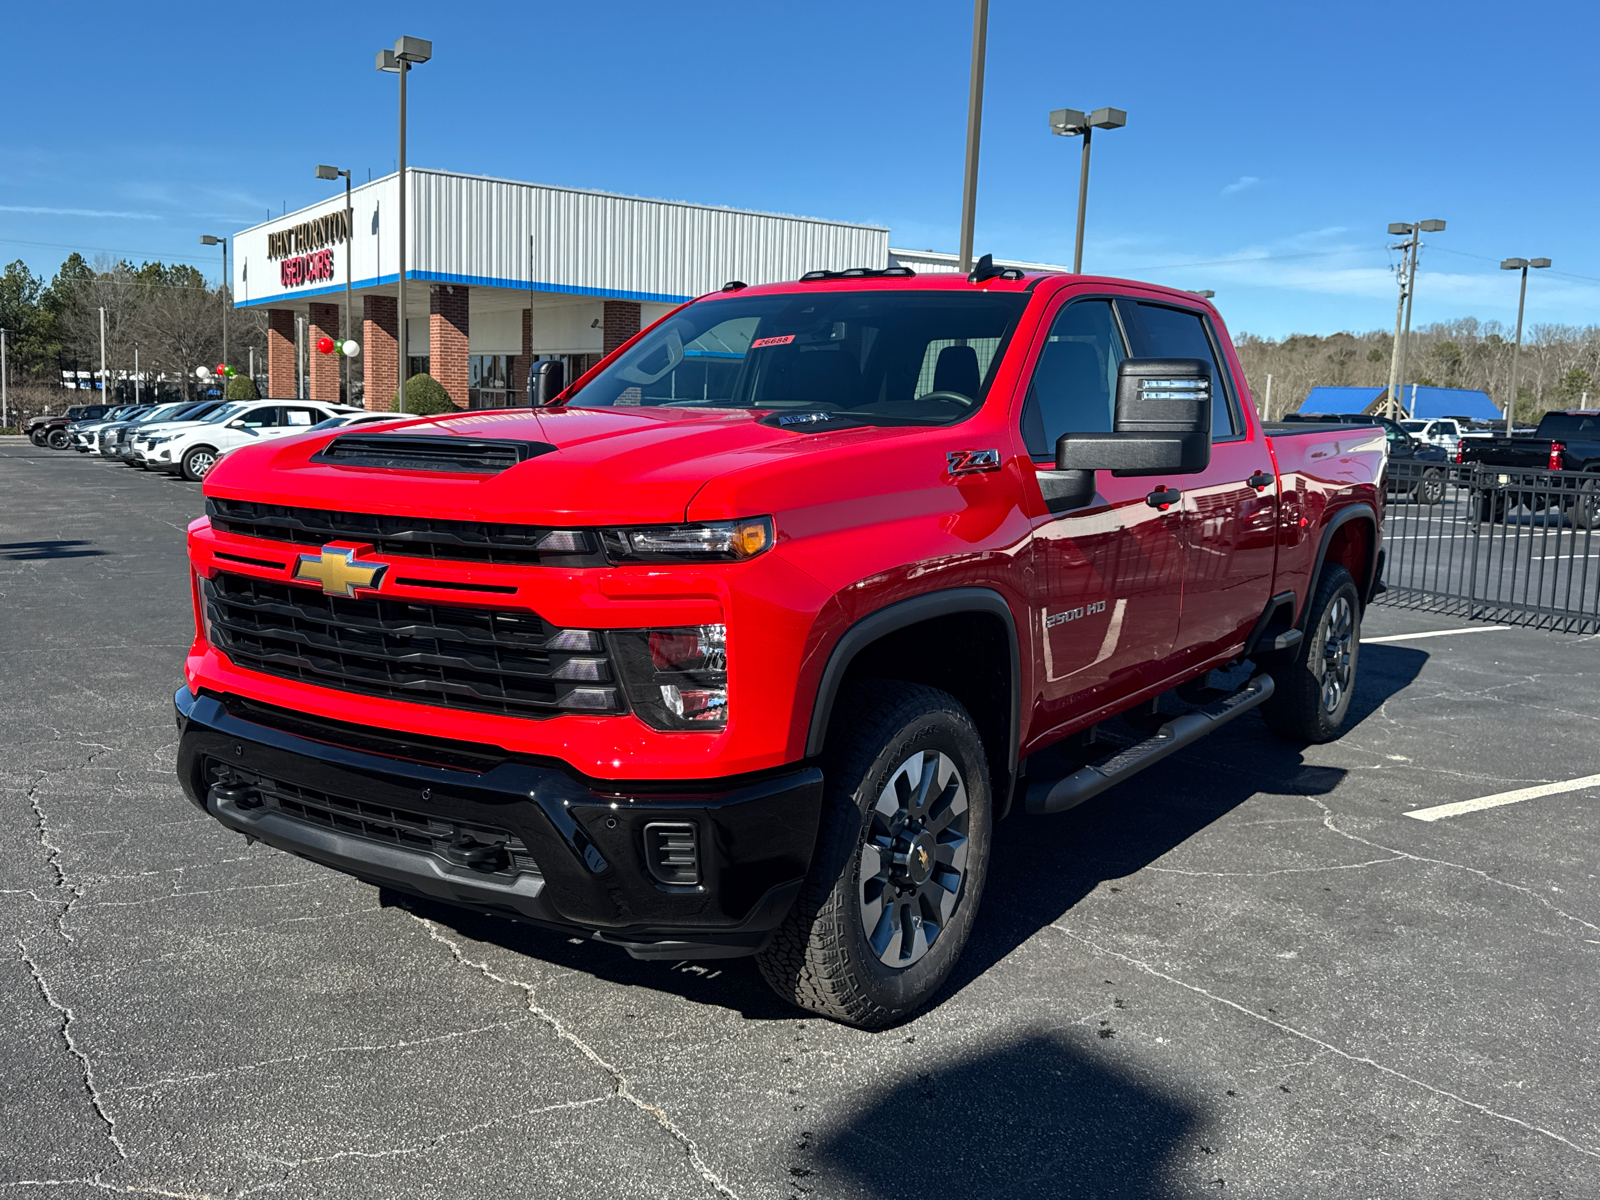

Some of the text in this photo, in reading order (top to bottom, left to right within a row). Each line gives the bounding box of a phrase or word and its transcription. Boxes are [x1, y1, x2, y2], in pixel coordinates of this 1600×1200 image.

[291, 207, 354, 253] THORNTON
[280, 248, 334, 289] USED CARS
[355, 458, 445, 470] CHEVROLET
[1046, 600, 1106, 628] 2500 HD
